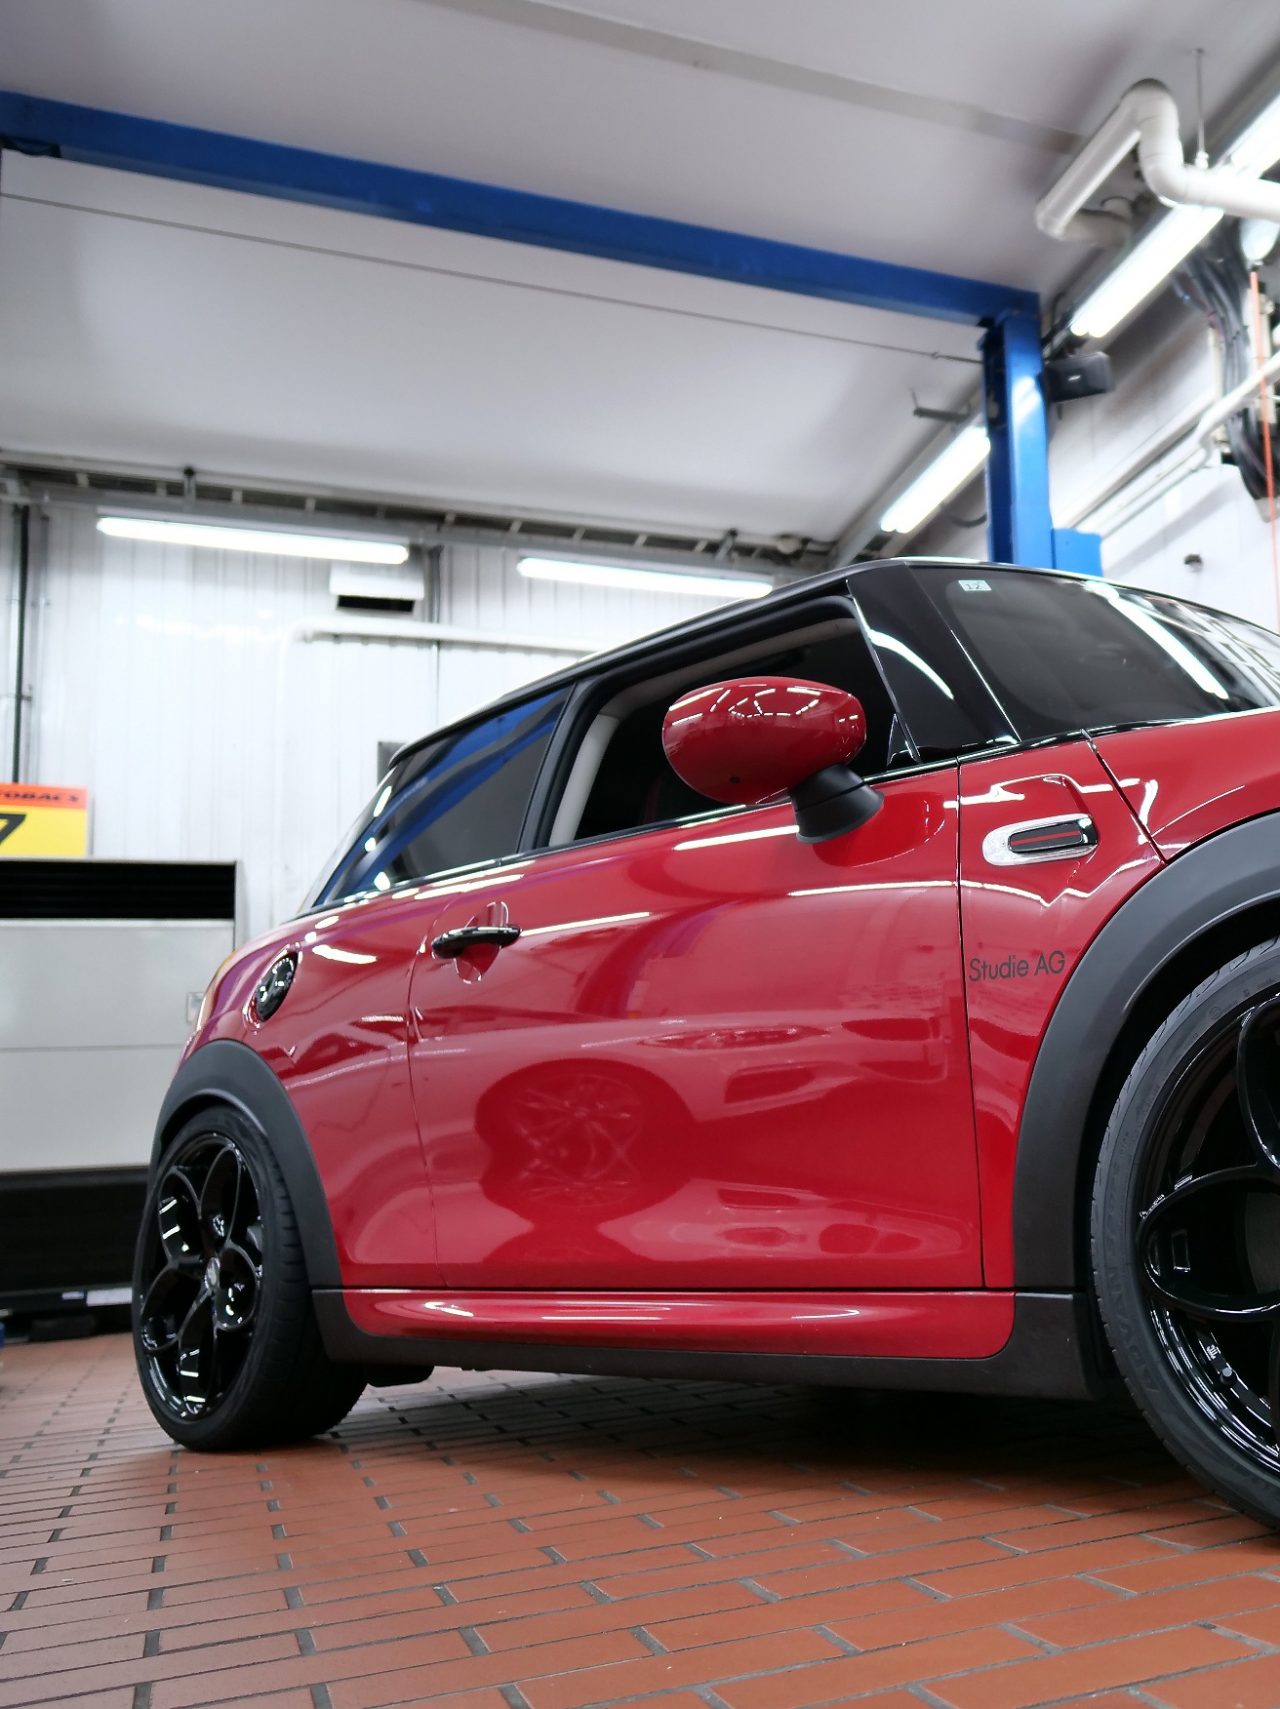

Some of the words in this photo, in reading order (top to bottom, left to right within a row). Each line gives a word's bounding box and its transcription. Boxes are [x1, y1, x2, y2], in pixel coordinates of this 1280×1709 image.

[0, 787, 79, 804] OBACS
[969, 955, 1029, 981] Studie
[1034, 950, 1065, 976] AG
